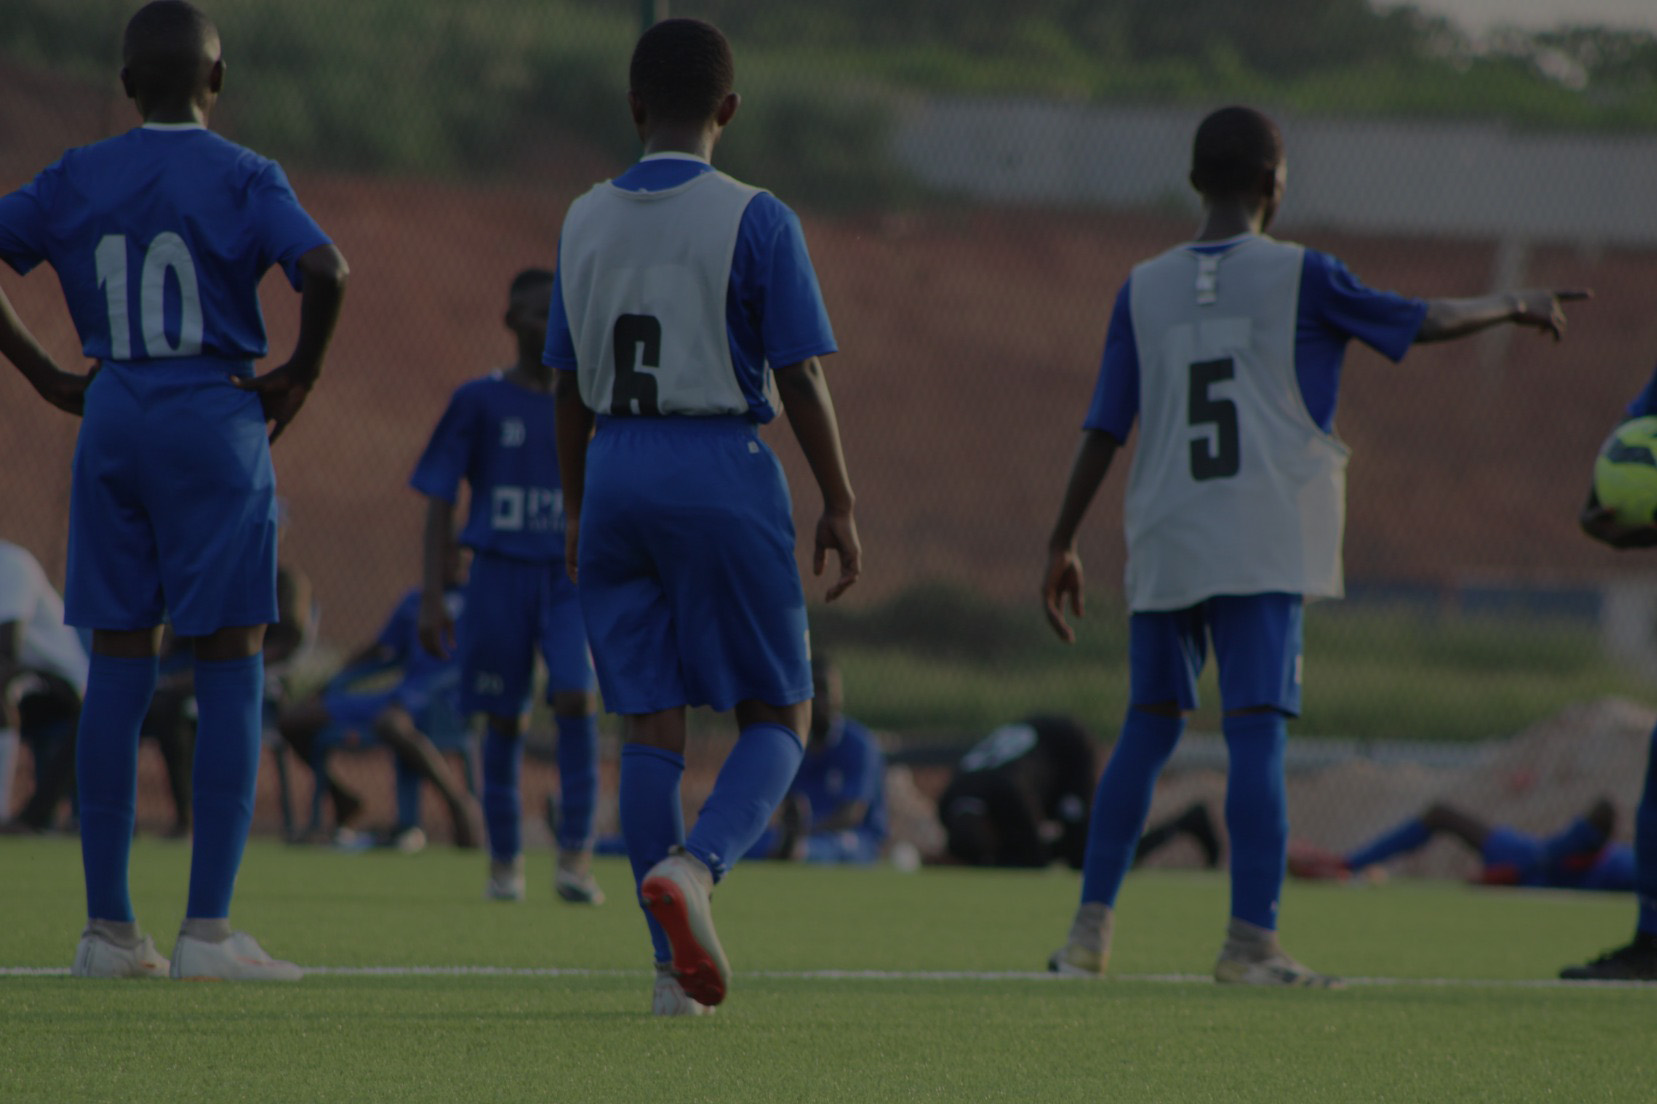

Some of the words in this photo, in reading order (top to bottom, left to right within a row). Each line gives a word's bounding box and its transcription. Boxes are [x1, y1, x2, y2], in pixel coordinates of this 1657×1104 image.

[94, 230, 204, 360] 10
[611, 313, 661, 415] 6
[1189, 357, 1239, 481] 5
